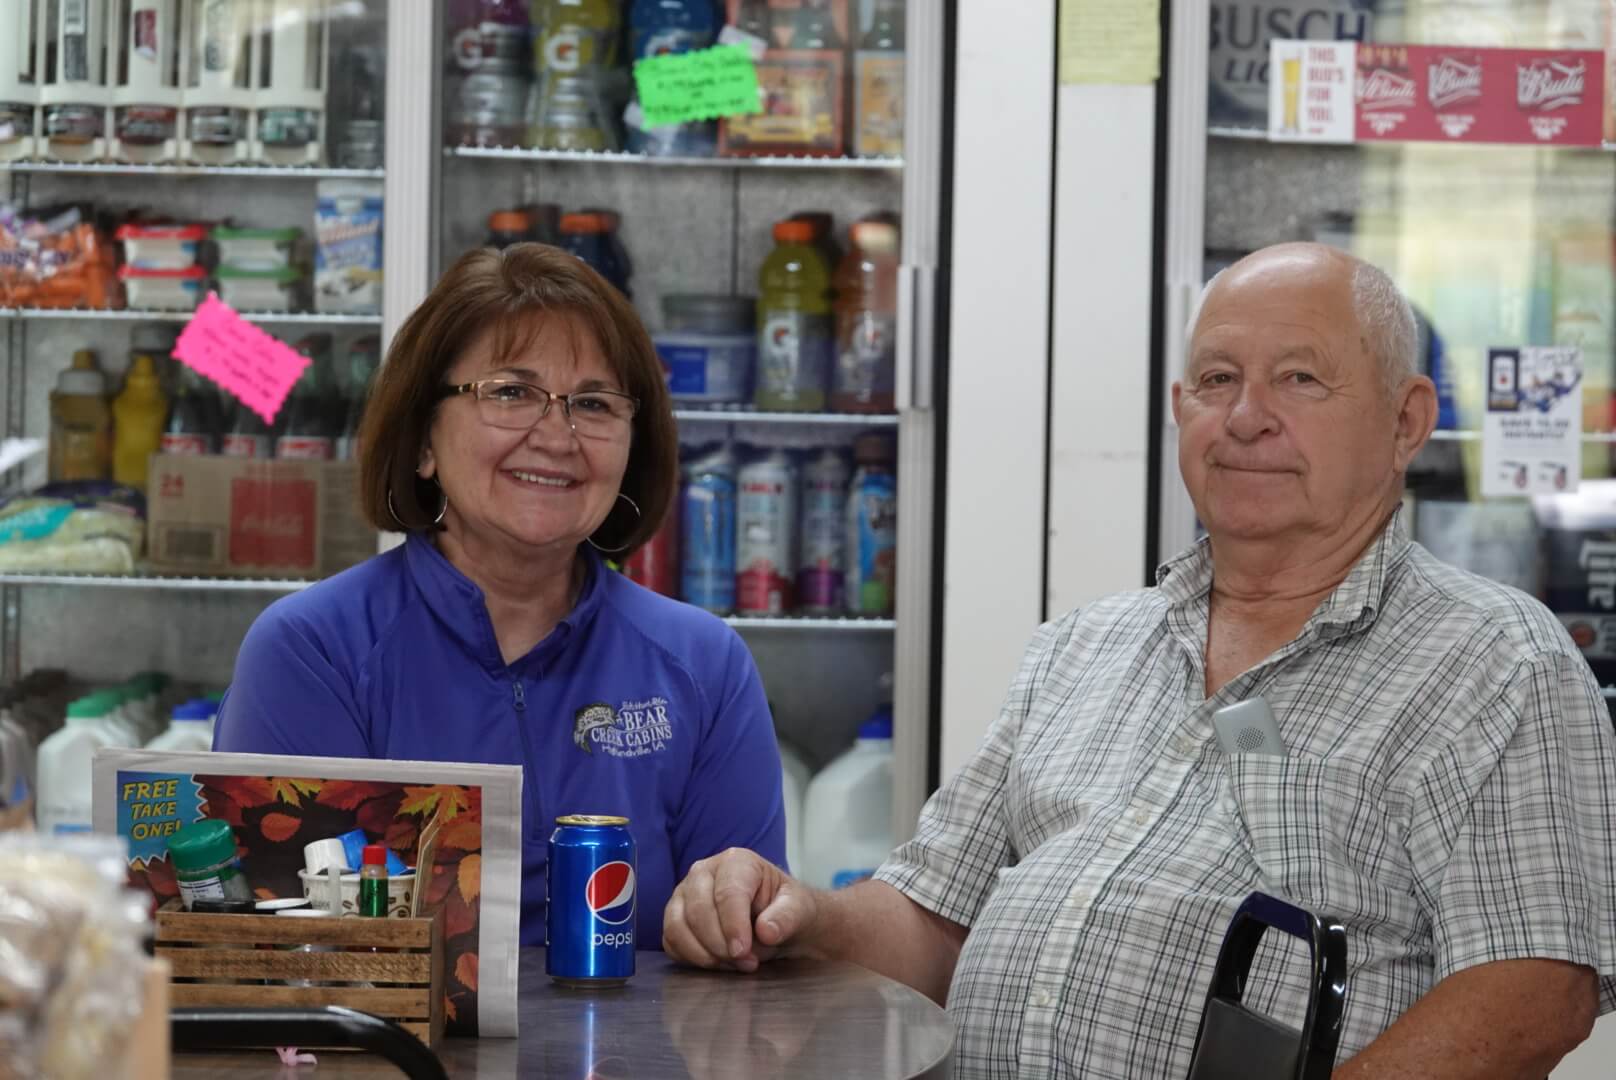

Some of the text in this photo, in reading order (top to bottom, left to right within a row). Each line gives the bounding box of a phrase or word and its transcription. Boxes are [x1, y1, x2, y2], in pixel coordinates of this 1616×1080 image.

[544, 32, 579, 71] G
[1308, 47, 1336, 63] THIS
[1308, 86, 1331, 102] FOR
[623, 706, 670, 731] BEAR
[625, 725, 673, 747] CABINS
[122, 779, 180, 801] FREE
[130, 801, 177, 820] TAKE
[132, 820, 182, 841] ONE!
[592, 929, 633, 949] pepsi
